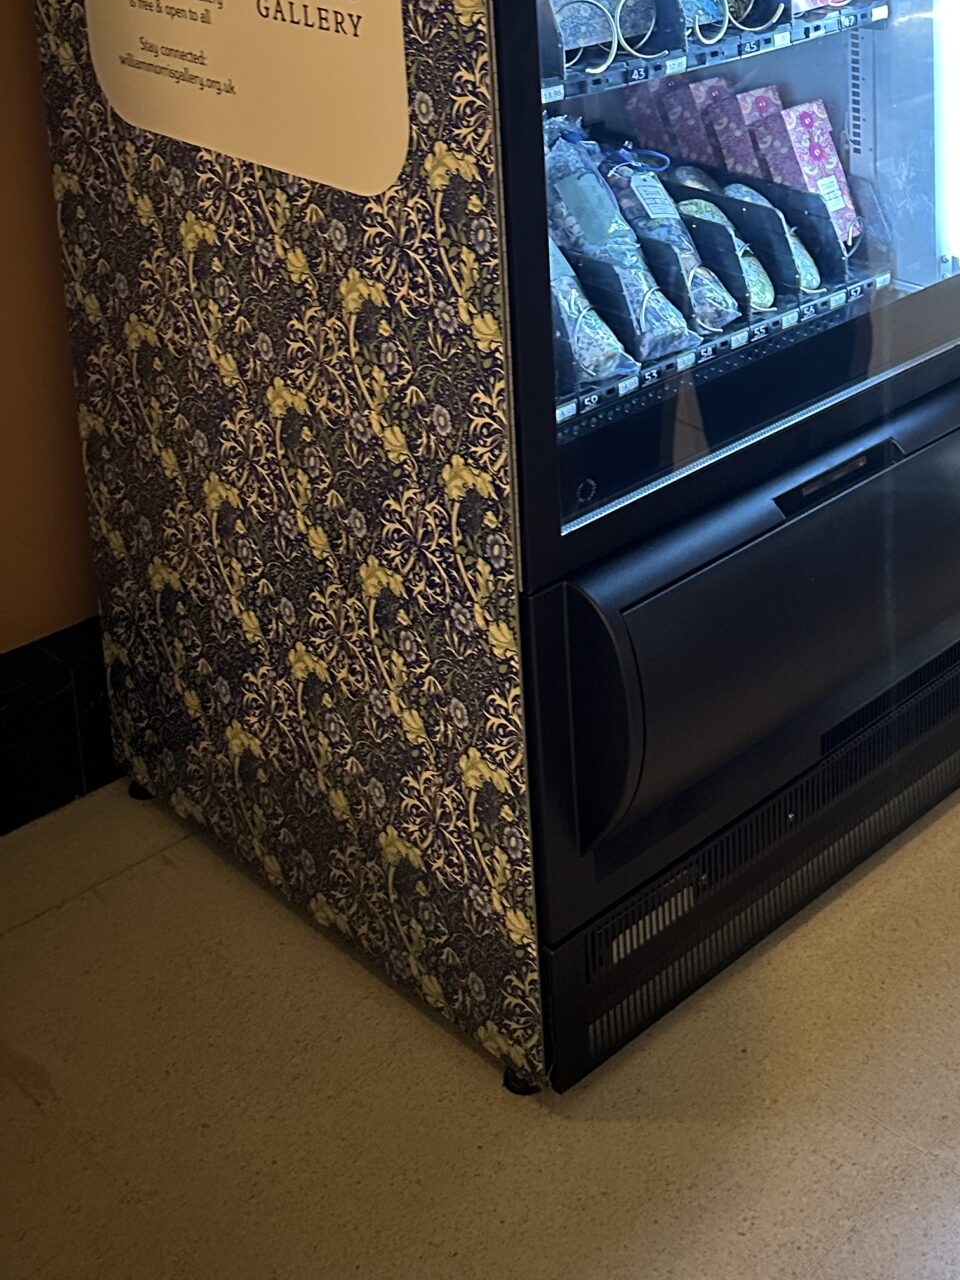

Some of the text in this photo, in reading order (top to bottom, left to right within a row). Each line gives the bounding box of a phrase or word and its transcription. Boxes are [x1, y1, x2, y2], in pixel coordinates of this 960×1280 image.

[164, 4, 187, 21] open
[188, 8, 198, 22] to
[200, 8, 212, 25] all
[139, 36, 208, 67] Stay connected:
[744, 41, 757, 53] 45
[631, 68, 646, 80] 43
[850, 286, 861, 298] 57
[754, 325, 766, 336] 55
[645, 369, 658, 381] 53
